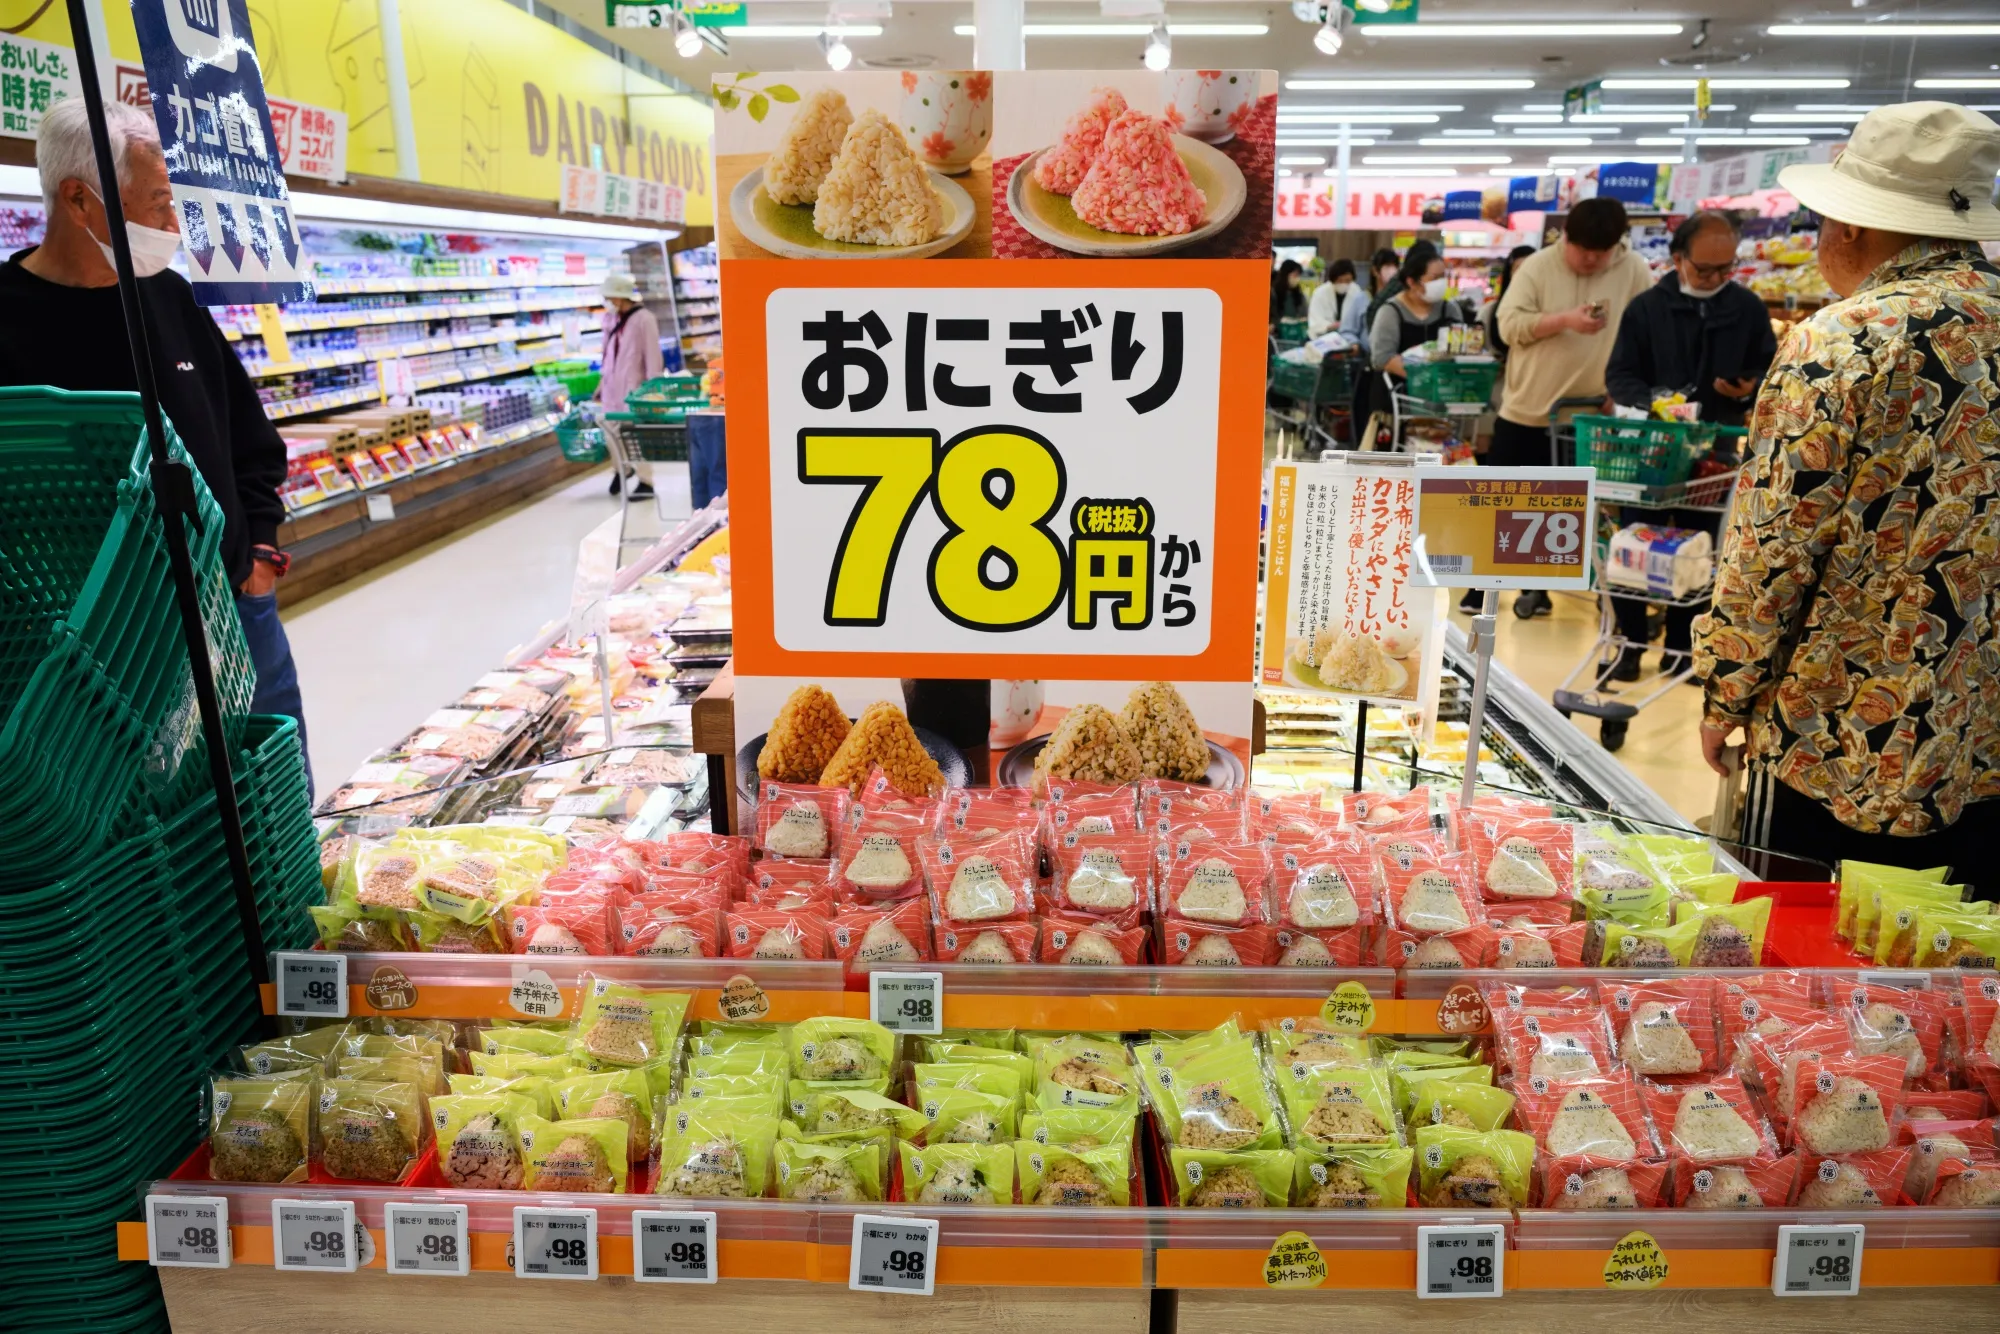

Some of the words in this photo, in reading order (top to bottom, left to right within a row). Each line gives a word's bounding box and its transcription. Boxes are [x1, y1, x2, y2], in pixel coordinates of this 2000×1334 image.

[1, 41, 68, 80] おいしさと
[523, 81, 628, 176] DAIRY
[637, 125, 705, 197] FOODS
[1603, 176, 1650, 189] FROZEN
[1275, 193, 1361, 217] RESH
[1374, 191, 1427, 217] ME
[801, 302, 1184, 415] おにぎり
[1475, 481, 1532, 494] お買得品
[1277, 475, 1292, 519] 福にぎり
[1469, 495, 1514, 507] 福にぎり
[1528, 496, 1585, 508] だしごはん
[1074, 501, 1152, 535] (税抜)
[1499, 512, 1580, 554] ¥78
[1273, 523, 1288, 576] だしごはん
[1343, 475, 1368, 639] お出汁の優しいおにぎり。
[1359, 476, 1394, 641] カラダにやさしい、
[1159, 534, 1201, 628] から
[782, 808, 820, 819] だしごはん
[862, 837, 901, 846] だしごはん
[1506, 844, 1546, 855] だしごはん
[1082, 855, 1123, 864] だしごはん
[964, 863, 1003, 875] だしごはん
[1193, 867, 1235, 878] だしごはん
[1308, 874, 1348, 885] だしごはん
[1422, 878, 1459, 888] だしごはん
[528, 945, 580, 953] 明太マヨネーズ
[636, 945, 690, 955] 明太マヨネーズ
[862, 942, 903, 957] だしごはん
[1195, 957, 1237, 966] だしごはん
[1296, 958, 1338, 967] だしごはん
[303, 981, 337, 1000] ¥98
[367, 981, 413, 995] マヨネーズの
[512, 987, 560, 1004] 辛子明太子
[719, 991, 765, 1008] 焼きシャケ
[1443, 992, 1481, 1009] 選べる
[524, 1001, 546, 1015] 使用
[598, 1003, 654, 1016] 和風ツナマヨネーズ
[727, 1004, 768, 1019] 粗ほぐし
[897, 998, 933, 1017] ¥98
[1327, 1000, 1372, 1014] うまみが
[1335, 1013, 1364, 1028] ぎゅっ!
[1660, 1010, 1670, 1020] 鮭
[1895, 1014, 1905, 1024] 梅
[1567, 1038, 1576, 1047] 鮭
[1202, 1088, 1220, 1101] 昆布
[1333, 1086, 1352, 1096] 昆布
[1579, 1092, 1591, 1101] 鮭
[1704, 1092, 1716, 1101] 鮭
[1858, 1093, 1868, 1103] 梅
[235, 1127, 262, 1137] 天たれ
[457, 1138, 504, 1150] 枝豆ひじき
[533, 1160, 595, 1168] 和風ツナマヨネーズ
[700, 1153, 719, 1164] 高菜
[1063, 1190, 1084, 1199] 昆布
[1737, 1193, 1748, 1203] 鮭
[1863, 1189, 1873, 1198] 梅
[1223, 1198, 1243, 1207] 昆布
[162, 1209, 189, 1217] 福にぎり
[649, 1224, 680, 1233] 福にぎり
[689, 1225, 706, 1233] 高菜
[177, 1227, 218, 1247] ¥98
[304, 1231, 344, 1251] ¥98
[869, 1230, 898, 1240] 福にぎり
[905, 1233, 927, 1241] わかめ
[416, 1234, 457, 1255] ¥98
[545, 1239, 587, 1260] ¥98
[1276, 1242, 1310, 1253] 北海道産
[1436, 1239, 1468, 1248] 福にぎり
[1477, 1239, 1493, 1247] 昆布
[664, 1242, 706, 1263] ¥98
[882, 1250, 925, 1273] ¥98
[1268, 1251, 1320, 1269] 真昆布の
[1808, 1255, 1850, 1277] ¥98
[1266, 1262, 1327, 1284] 旨みたっぷり!
[1450, 1256, 1493, 1278] ¥98
